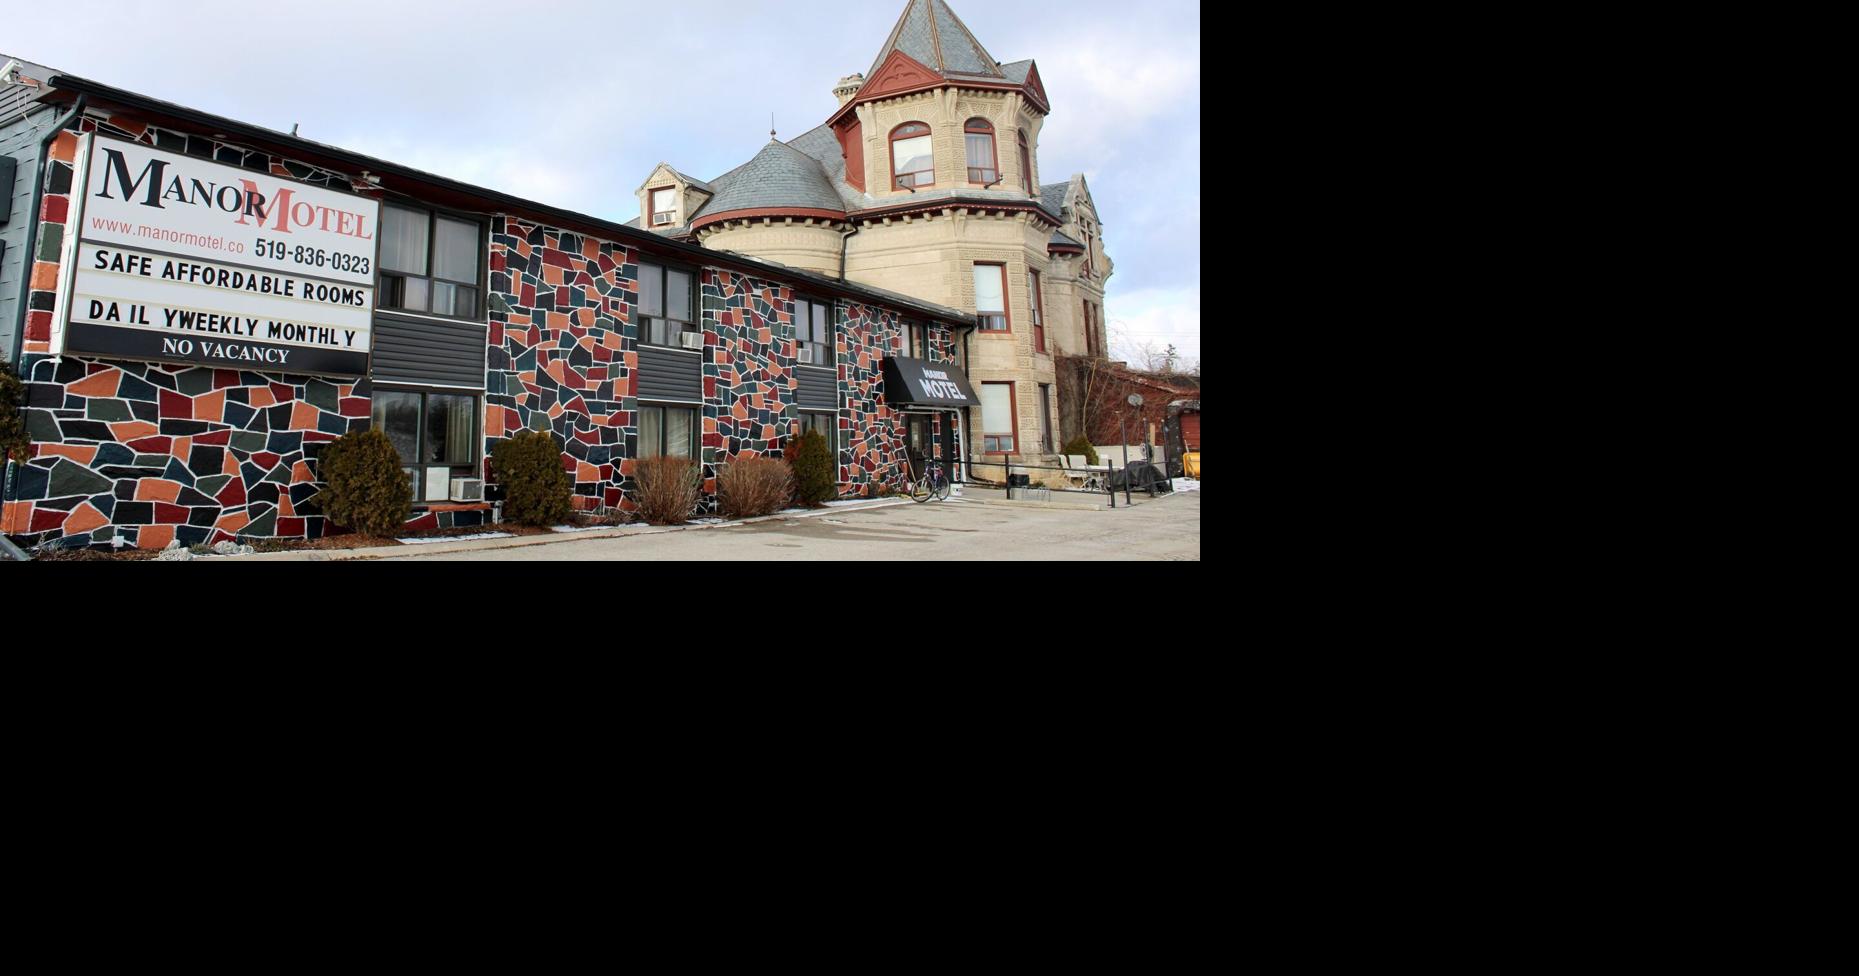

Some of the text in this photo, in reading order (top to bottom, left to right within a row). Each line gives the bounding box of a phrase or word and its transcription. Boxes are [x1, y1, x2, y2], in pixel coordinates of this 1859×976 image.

[95, 147, 372, 240] MANOR MOTEL
[92, 217, 244, 253] www.manormotel.co
[255, 238, 369, 275] 519-836-0323
[95, 251, 364, 306] SAFE AFFORDABLE ROOMS
[162, 337, 290, 363] NO VACANCY
[919, 379, 967, 400] MOTEL
